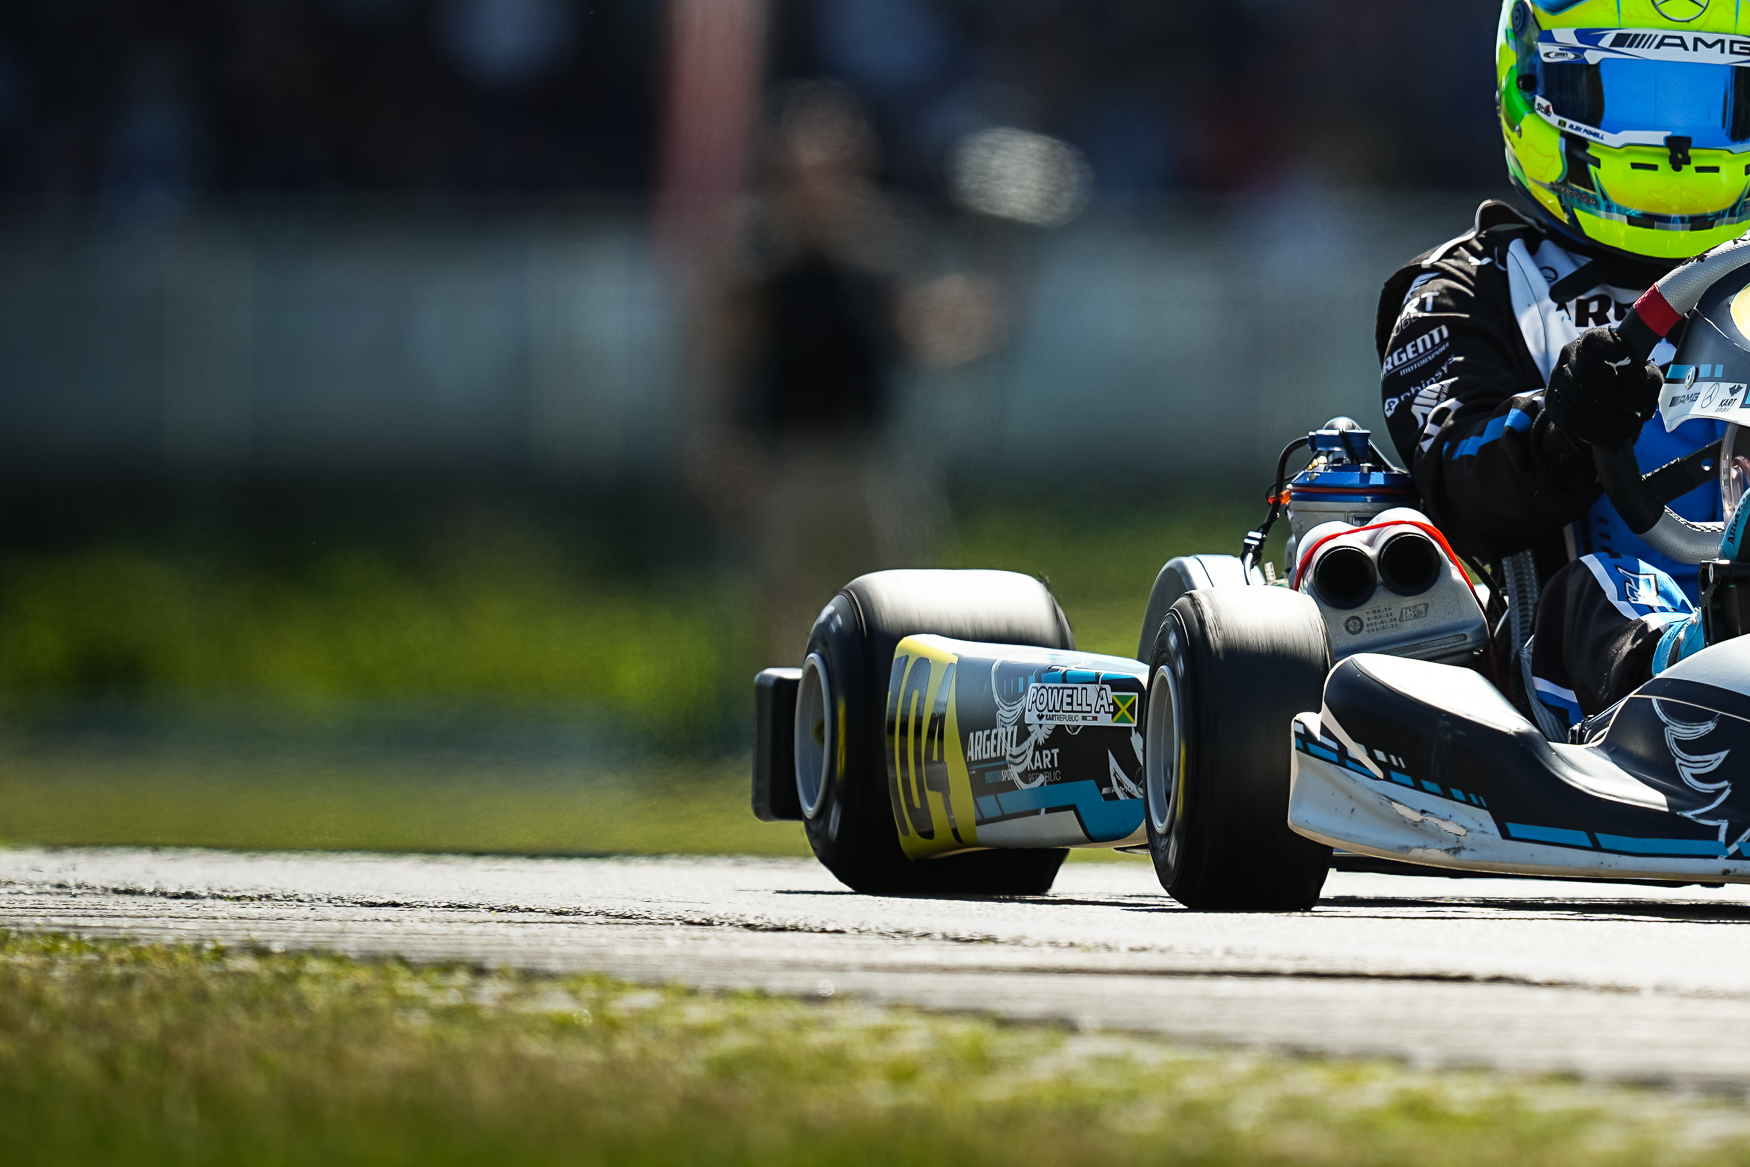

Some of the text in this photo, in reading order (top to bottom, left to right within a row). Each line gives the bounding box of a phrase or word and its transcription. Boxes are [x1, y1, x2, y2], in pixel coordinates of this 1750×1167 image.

[1028, 686, 1092, 713] POWELL
[886, 654, 965, 845] 104
[1027, 748, 1060, 771] KART
